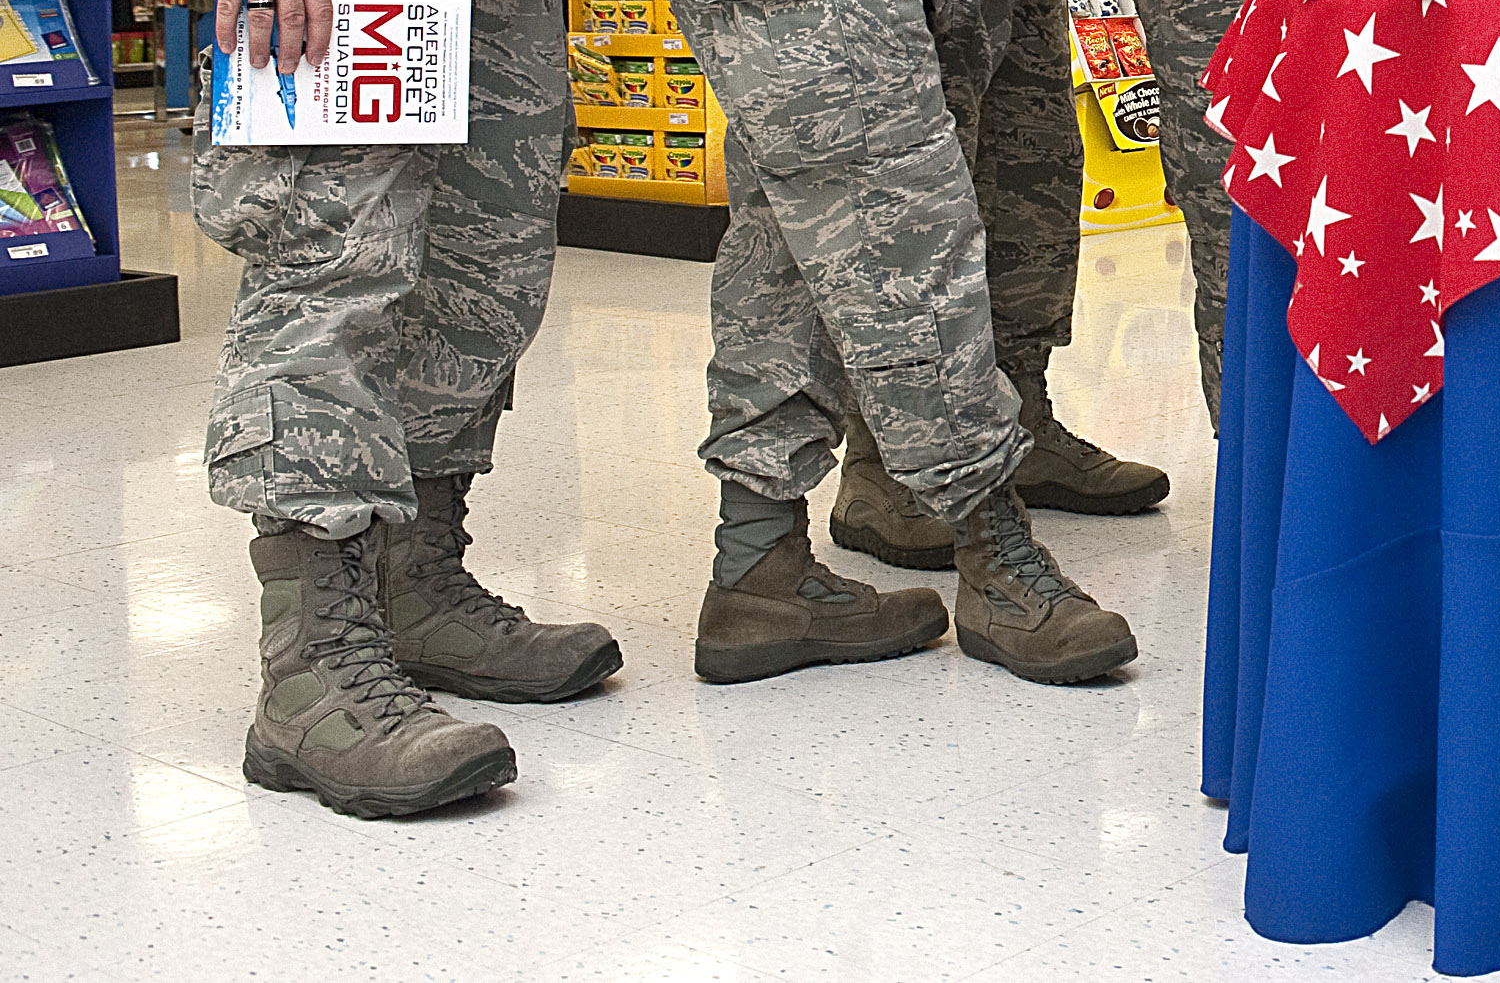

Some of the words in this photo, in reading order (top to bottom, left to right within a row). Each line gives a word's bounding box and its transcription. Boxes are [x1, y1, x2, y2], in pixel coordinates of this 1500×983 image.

[323, 75, 330, 84] OF
[335, 3, 350, 124] SQUADRON
[351, 4, 404, 124] MiG
[405, 4, 424, 123] SECRET
[424, 5, 439, 124] AMERICA'S
[1099, 84, 1116, 98] New!
[1120, 91, 1137, 105] Milk
[1126, 100, 1151, 113] Whole
